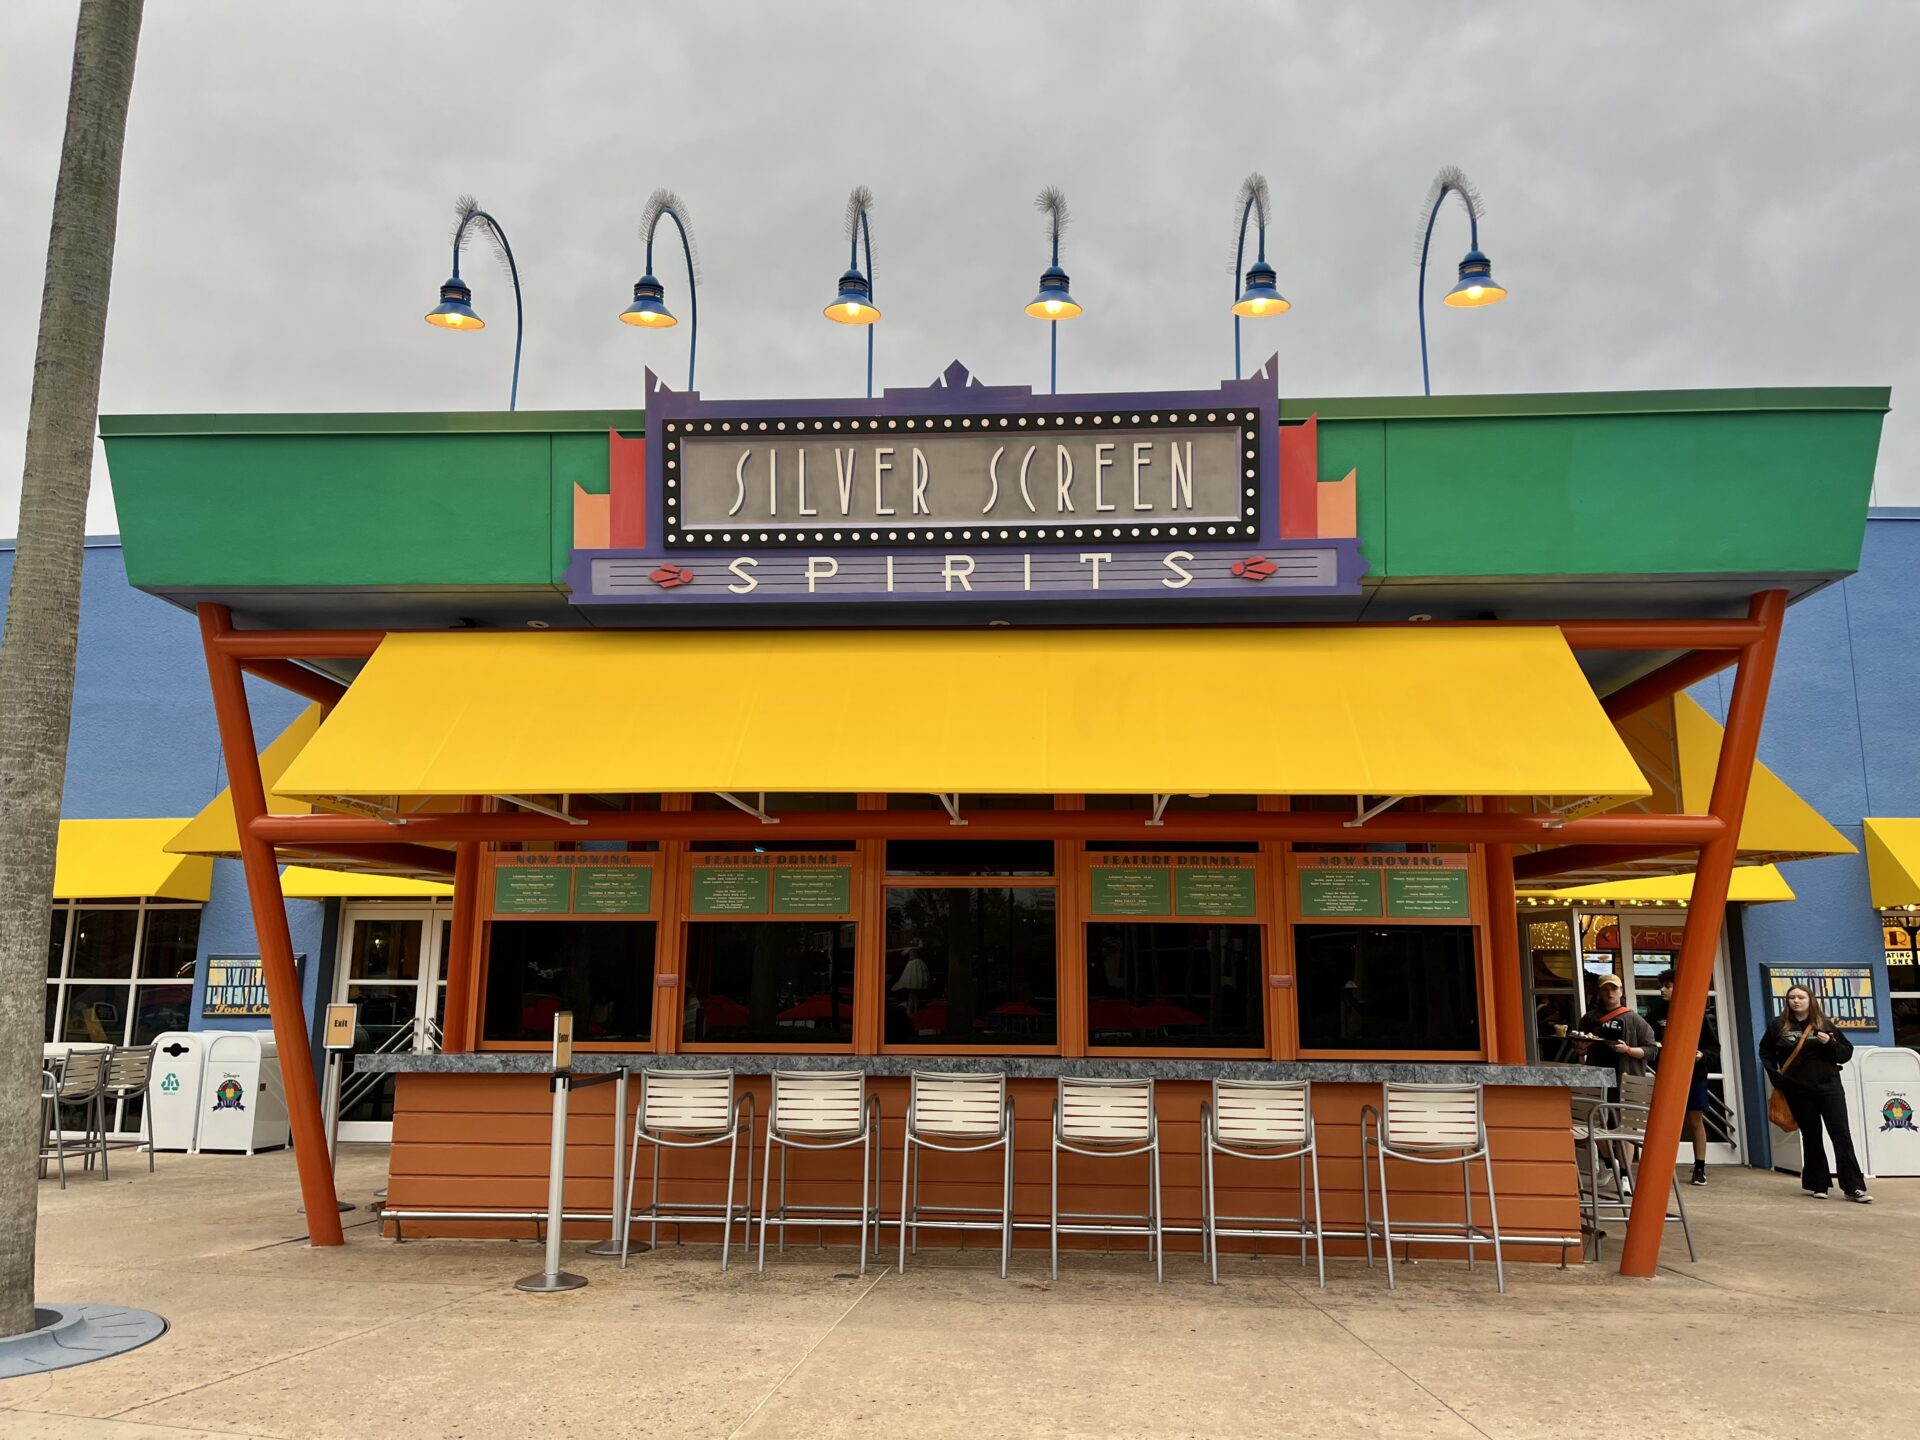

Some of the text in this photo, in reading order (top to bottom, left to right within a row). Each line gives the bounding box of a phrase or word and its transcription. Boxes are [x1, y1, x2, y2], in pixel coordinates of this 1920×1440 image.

[729, 441, 1193, 516] SILVER SCREEN
[728, 551, 1195, 594] SPIRITS
[516, 855, 632, 864] NOW SHOWING
[704, 855, 838, 864] FEATURE DRINKS
[1103, 856, 1241, 865] FEATURE DRINKS
[1319, 856, 1443, 866] NOW SHOWING
[226, 967, 267, 986] WORL
[214, 1004, 248, 1014] Food
[334, 1019, 347, 1027] Exit
